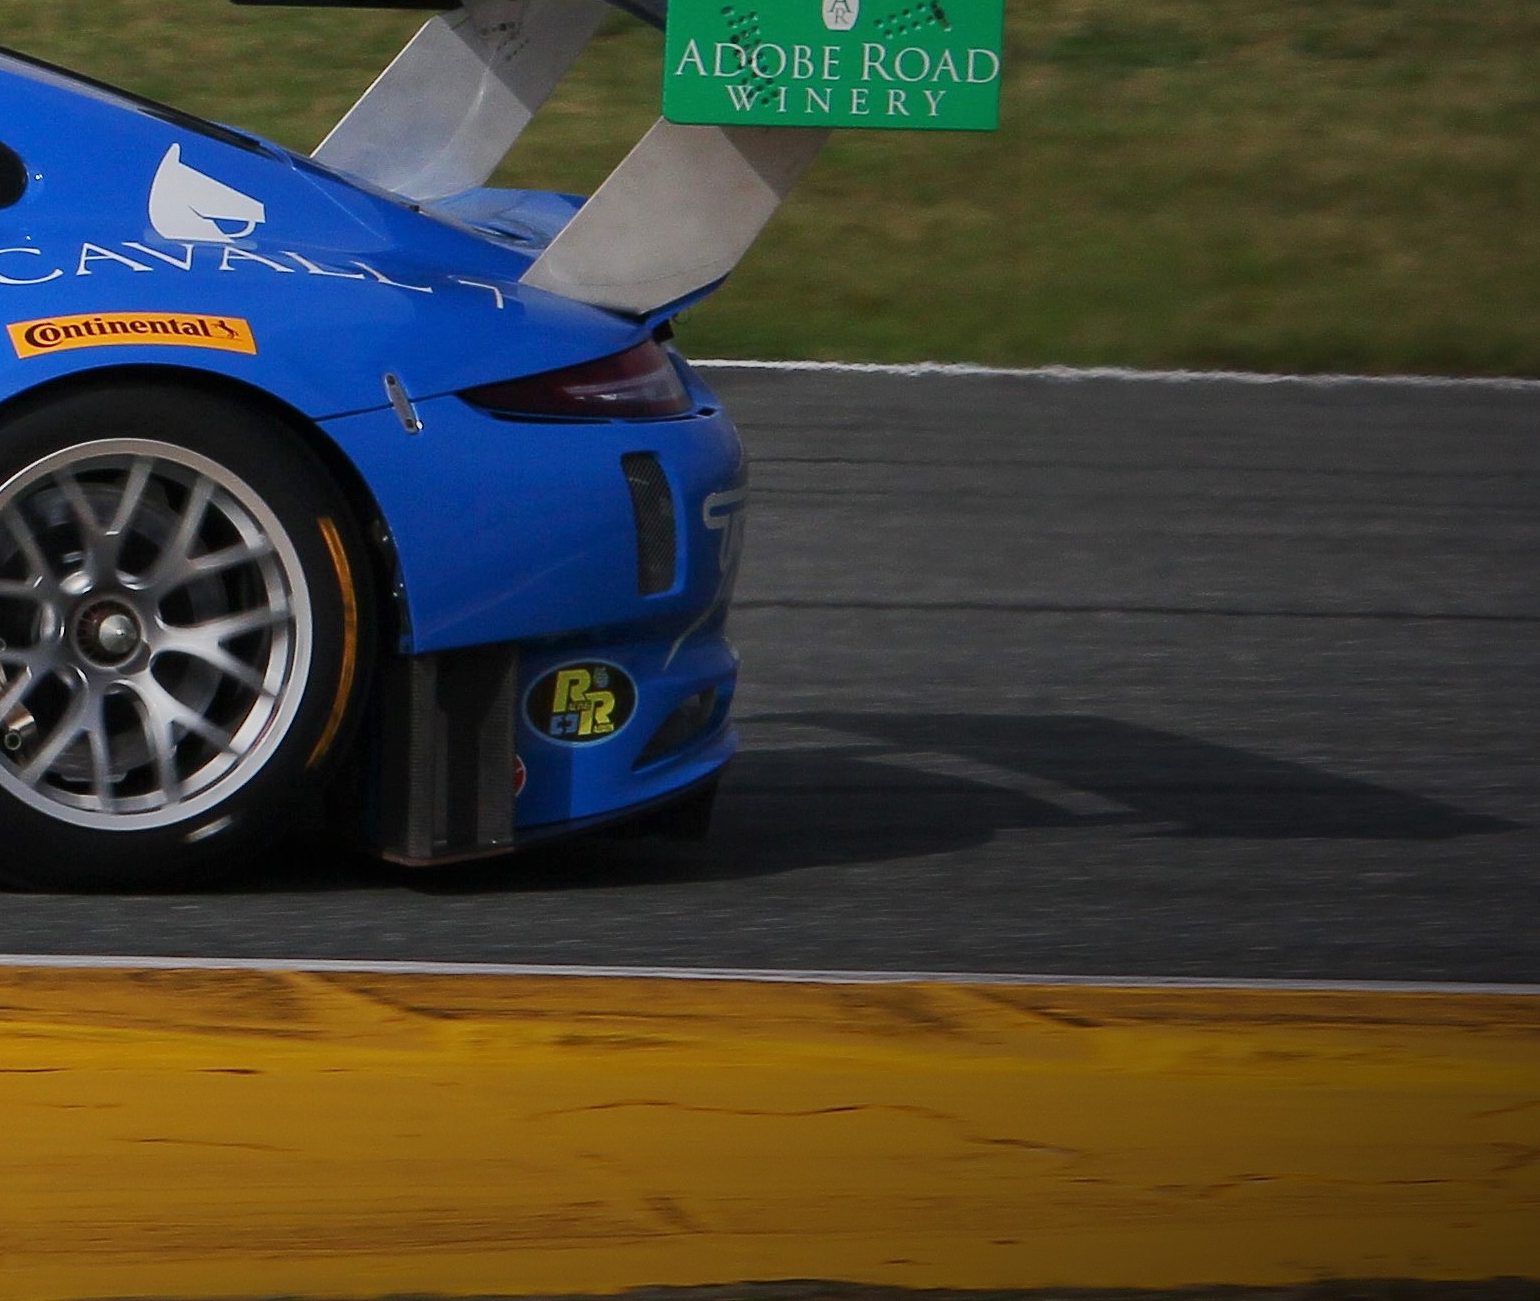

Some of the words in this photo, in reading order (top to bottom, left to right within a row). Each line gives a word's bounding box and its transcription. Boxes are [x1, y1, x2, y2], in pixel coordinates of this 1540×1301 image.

[674, 39, 841, 80] ADOBE
[862, 43, 1000, 85] ROAD
[725, 85, 946, 117] WINERY
[24, 317, 213, 348] Continental
